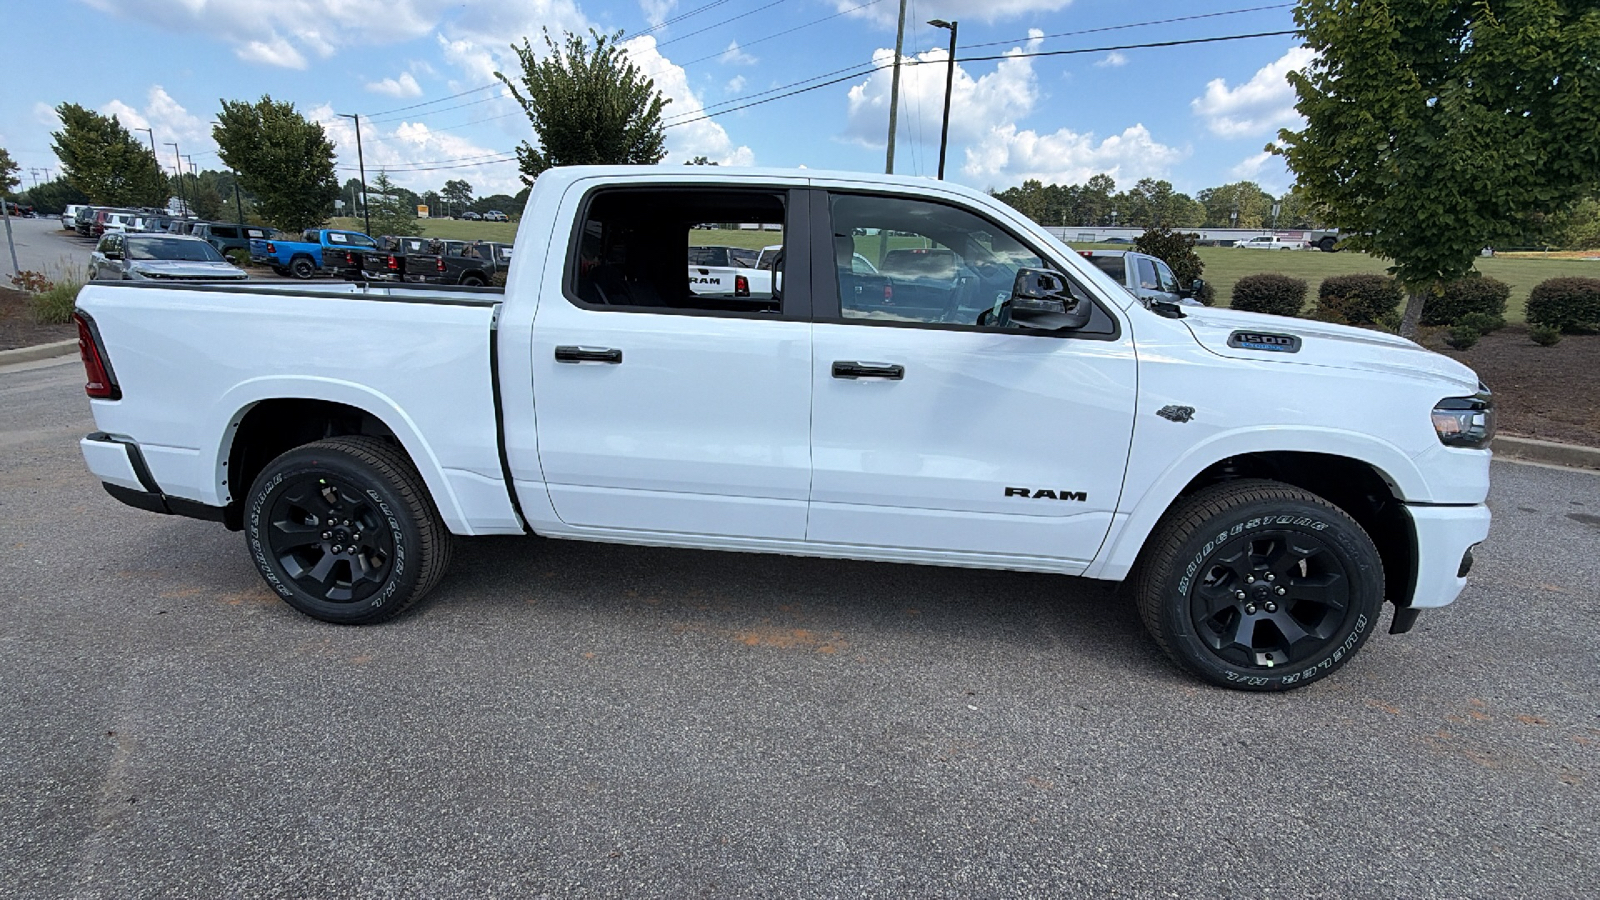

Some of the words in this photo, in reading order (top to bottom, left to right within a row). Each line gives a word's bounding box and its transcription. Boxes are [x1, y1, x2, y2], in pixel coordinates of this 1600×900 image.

[689, 277, 720, 285] RAM
[1239, 333, 1291, 345] 1500
[1004, 486, 1088, 502] RAM
[248, 472, 294, 598] BRIDGESTONE
[366, 489, 405, 576] DUELER
[1177, 515, 1329, 597] BRIDGESTONE
[1281, 613, 1368, 685] DUELER
